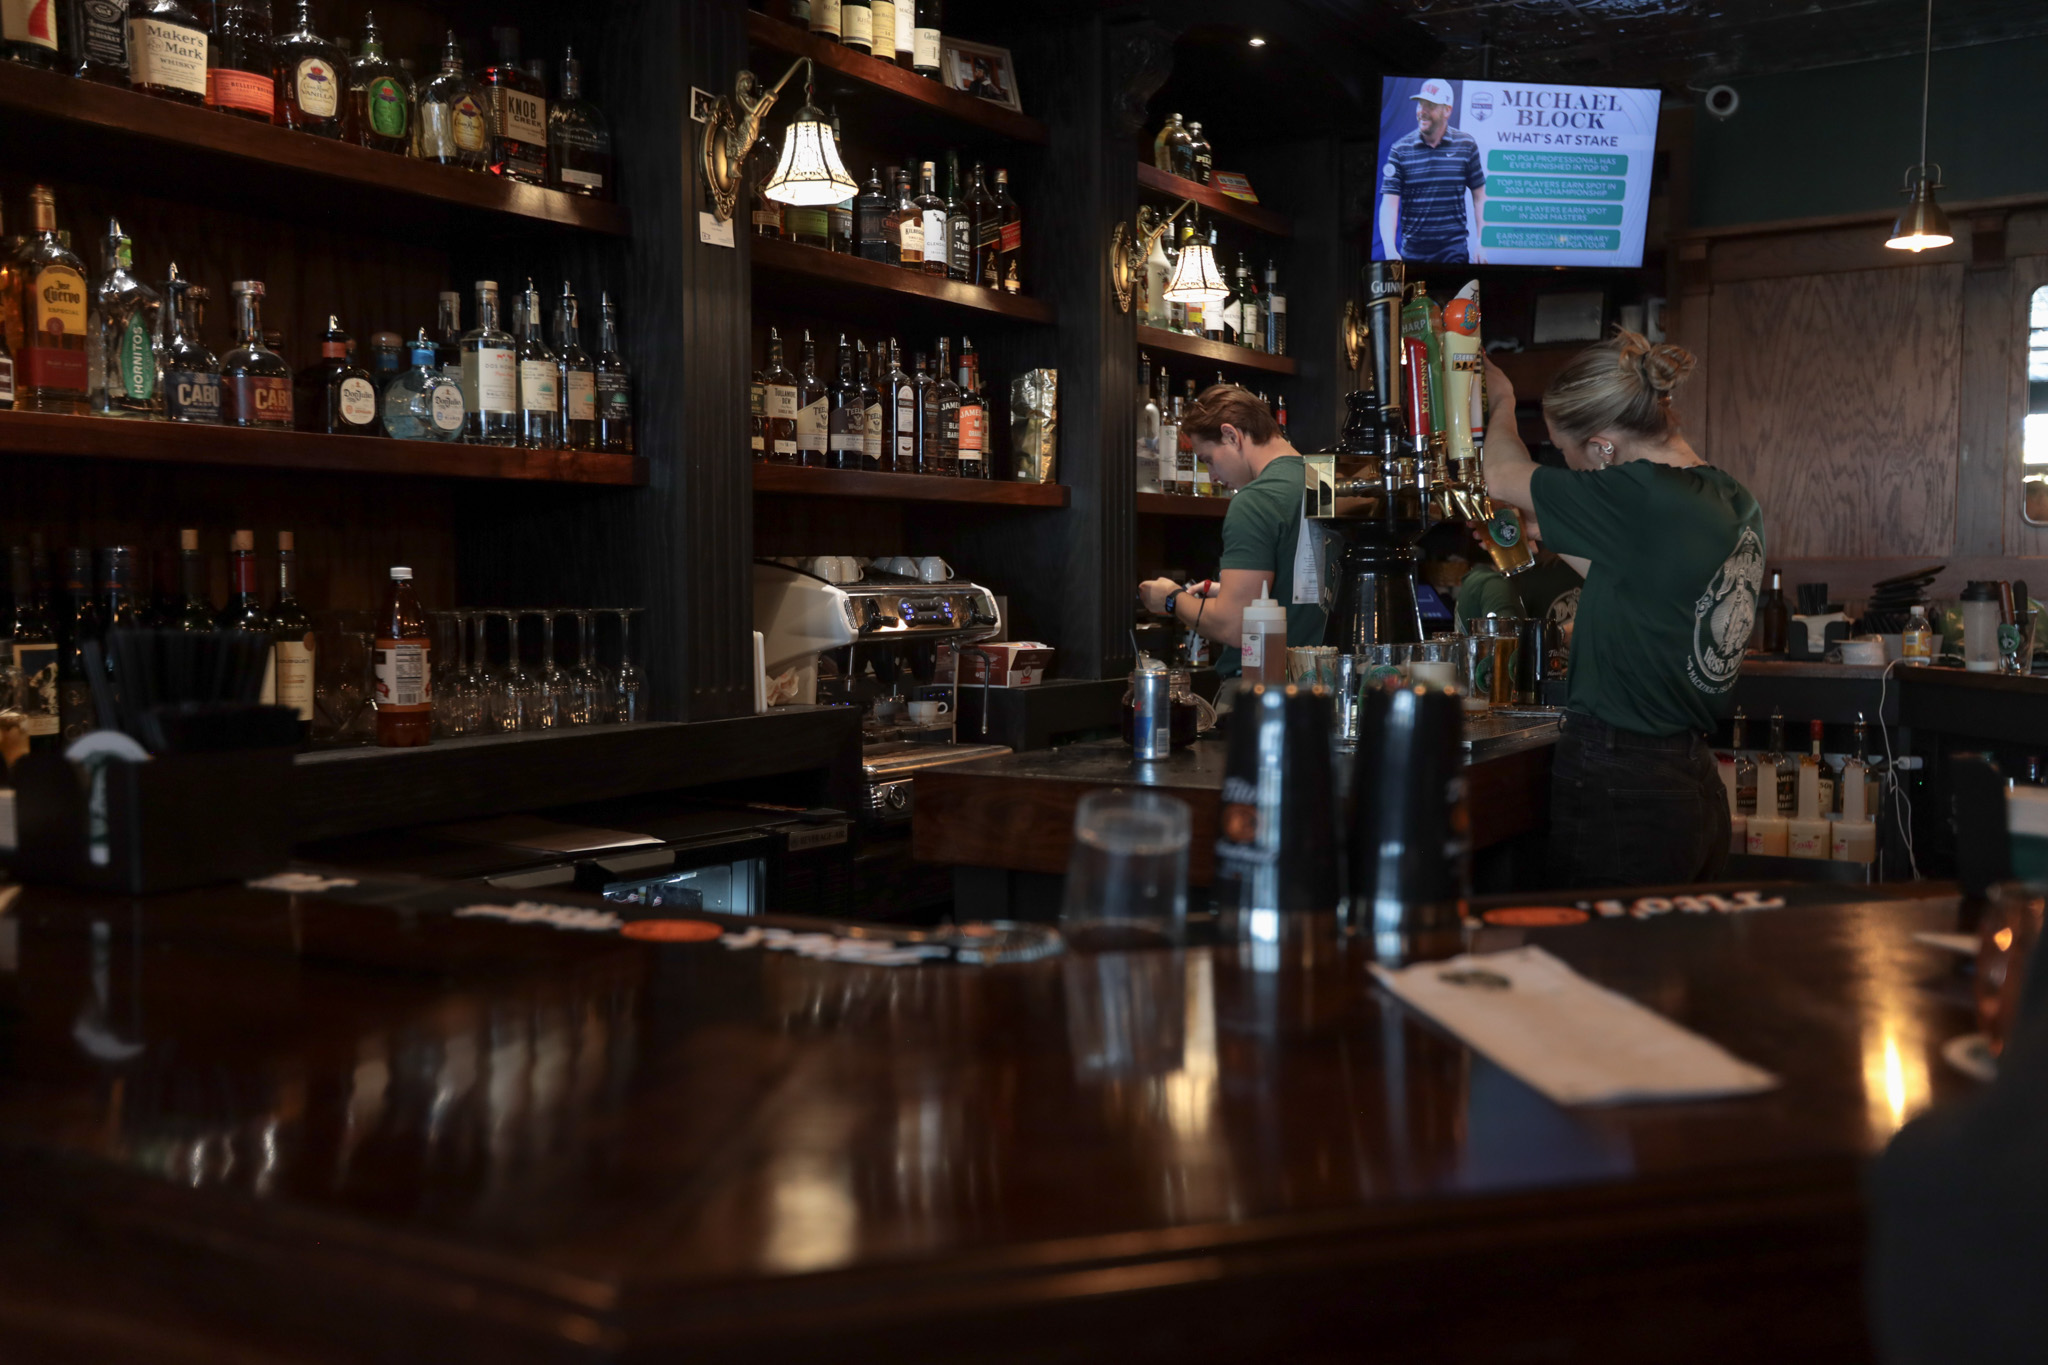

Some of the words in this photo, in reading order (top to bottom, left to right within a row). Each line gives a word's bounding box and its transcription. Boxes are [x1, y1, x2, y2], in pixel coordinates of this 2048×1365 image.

[146, 25, 205, 48] Maker's
[164, 41, 204, 61] Mark
[159, 57, 197, 71] WHISKY
[301, 89, 334, 101] VANILLA
[1501, 89, 1622, 112] MICHAEL
[508, 96, 537, 120] KNOB
[513, 115, 543, 128] CREEK
[1516, 109, 1606, 130] BLOCK
[1497, 131, 1552, 146] WHAT'S
[1554, 133, 1573, 146] AT
[1575, 134, 1619, 148] STAKE
[1503, 154, 1517, 162] NO
[1517, 155, 1535, 163] PGA
[1536, 156, 1598, 165] PROFESSIONAL
[1599, 158, 1617, 166] HAS
[1509, 162, 1532, 170] EVER
[1533, 163, 1571, 171] FINISHED
[1497, 179, 1514, 187] TOP
[1524, 180, 1560, 189] PLAYERS
[1561, 181, 1585, 190] EARN
[1585, 183, 1607, 191] SPOT
[1504, 187, 1525, 195] 2024
[1525, 188, 1543, 196] PGA
[1543, 189, 1608, 198] CHAMPIONSHIP
[1500, 204, 1517, 212] TOP
[1524, 205, 1561, 214] PLAYERS
[1561, 207, 1585, 215] EARN
[1585, 208, 1607, 216] SPOT
[1518, 212, 1528, 220] IN
[1529, 213, 1549, 221] 2024
[1549, 214, 1588, 222] MASTERS
[1496, 232, 1524, 241] EARNS
[1525, 234, 1557, 242] SPECIAL
[1498, 239, 1553, 248] MEMBERSHIP
[1565, 241, 1583, 249] PGA
[43, 286, 81, 304] Cuervo
[47, 306, 79, 316] ESPECIAL
[1401, 319, 1426, 333] HARP
[133, 326, 144, 394] HORNITOS
[1420, 357, 1429, 414] KILKENNY
[177, 383, 221, 407] CABO
[774, 387, 796, 399] TULLAMORE
[1703, 645, 1725, 675] IRISH
[1688, 669, 1717, 695] MACKINAC
